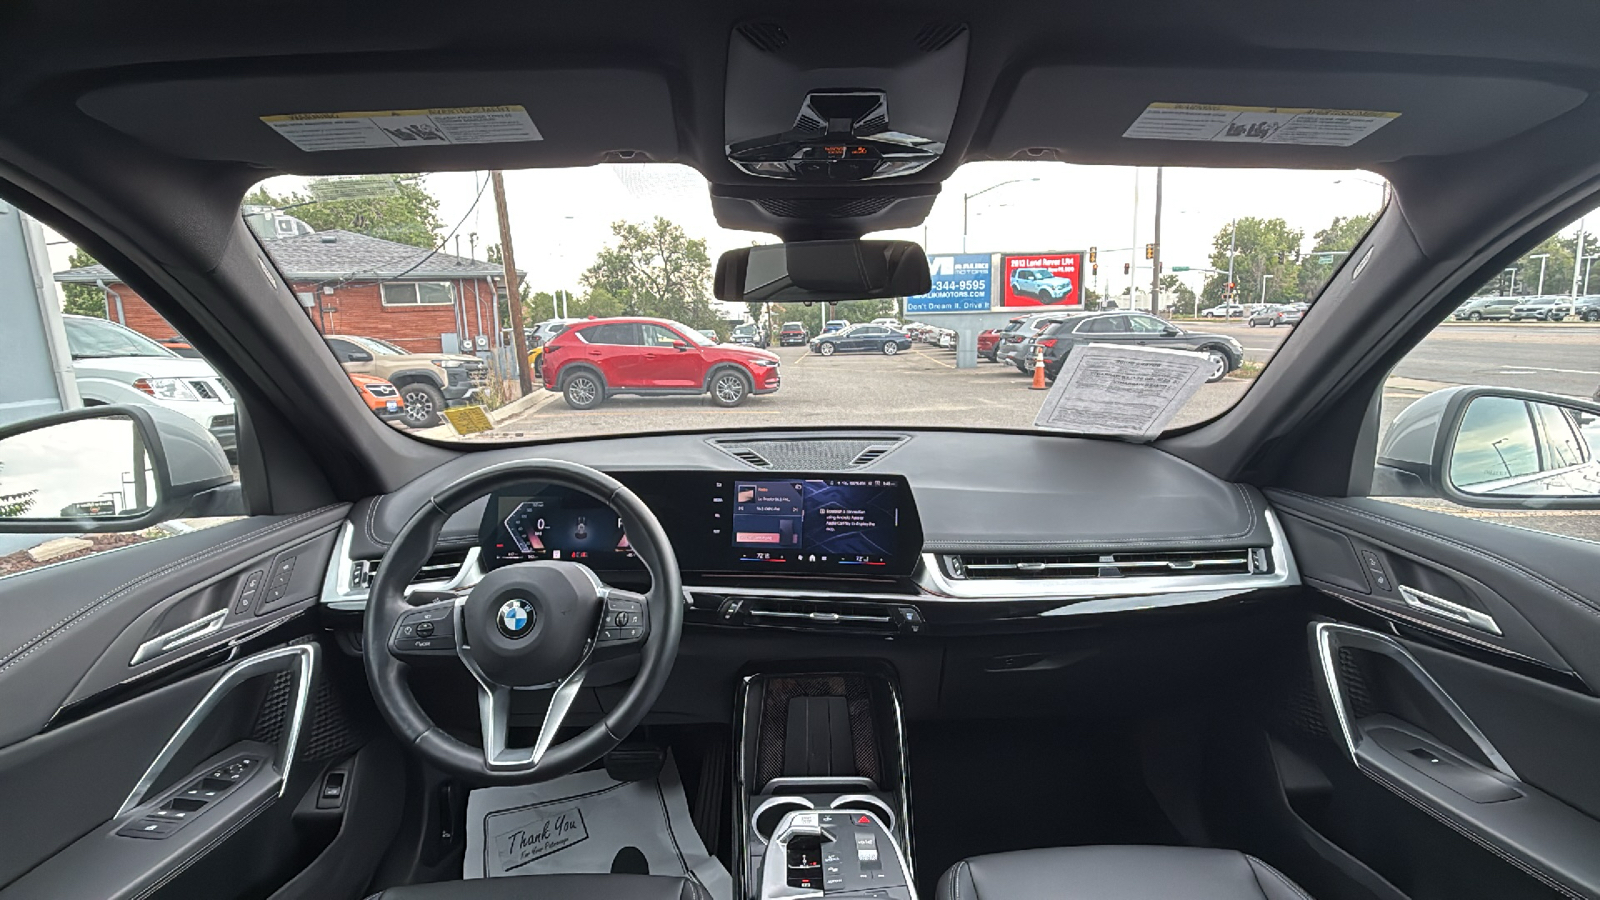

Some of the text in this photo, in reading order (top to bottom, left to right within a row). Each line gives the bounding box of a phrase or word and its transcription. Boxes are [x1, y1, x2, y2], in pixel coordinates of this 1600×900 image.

[1027, 258, 1042, 267] Land
[1043, 258, 1060, 266] Rover
[932, 279, 986, 291] -344-9595
[913, 291, 985, 299] LIKIMOTORS.COM
[907, 303, 926, 311] Don't
[928, 302, 952, 310] Dream
[963, 301, 983, 309] Drive
[508, 814, 577, 855] Thank You
